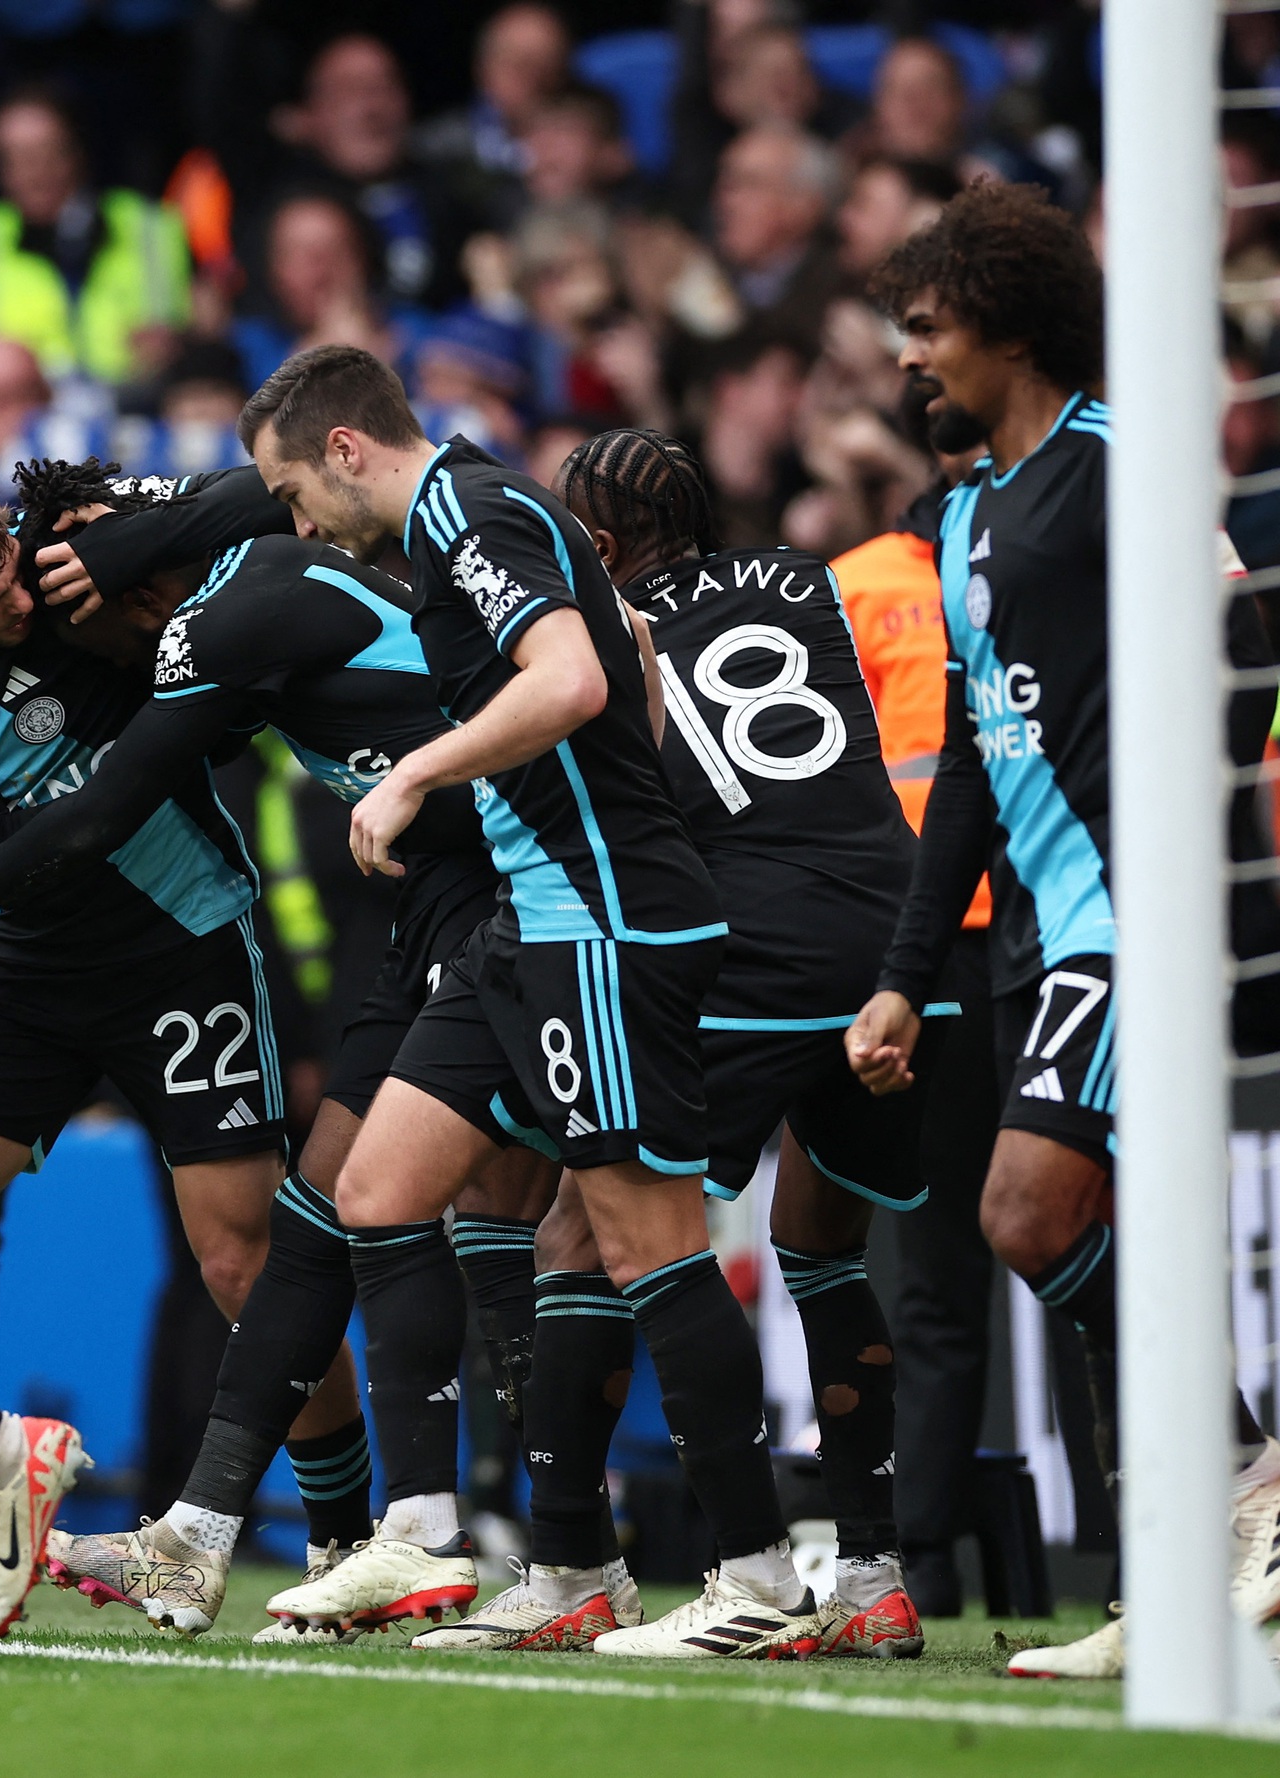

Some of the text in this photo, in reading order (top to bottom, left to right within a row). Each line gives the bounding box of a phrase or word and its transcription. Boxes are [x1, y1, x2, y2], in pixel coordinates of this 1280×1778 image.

[656, 623, 847, 816] 18
[152, 1002, 260, 1094] 22
[1023, 970, 1109, 1060] 17
[541, 1017, 582, 1104] 8
[495, 1389, 515, 1402] FC
[529, 1451, 554, 1464] CFC
